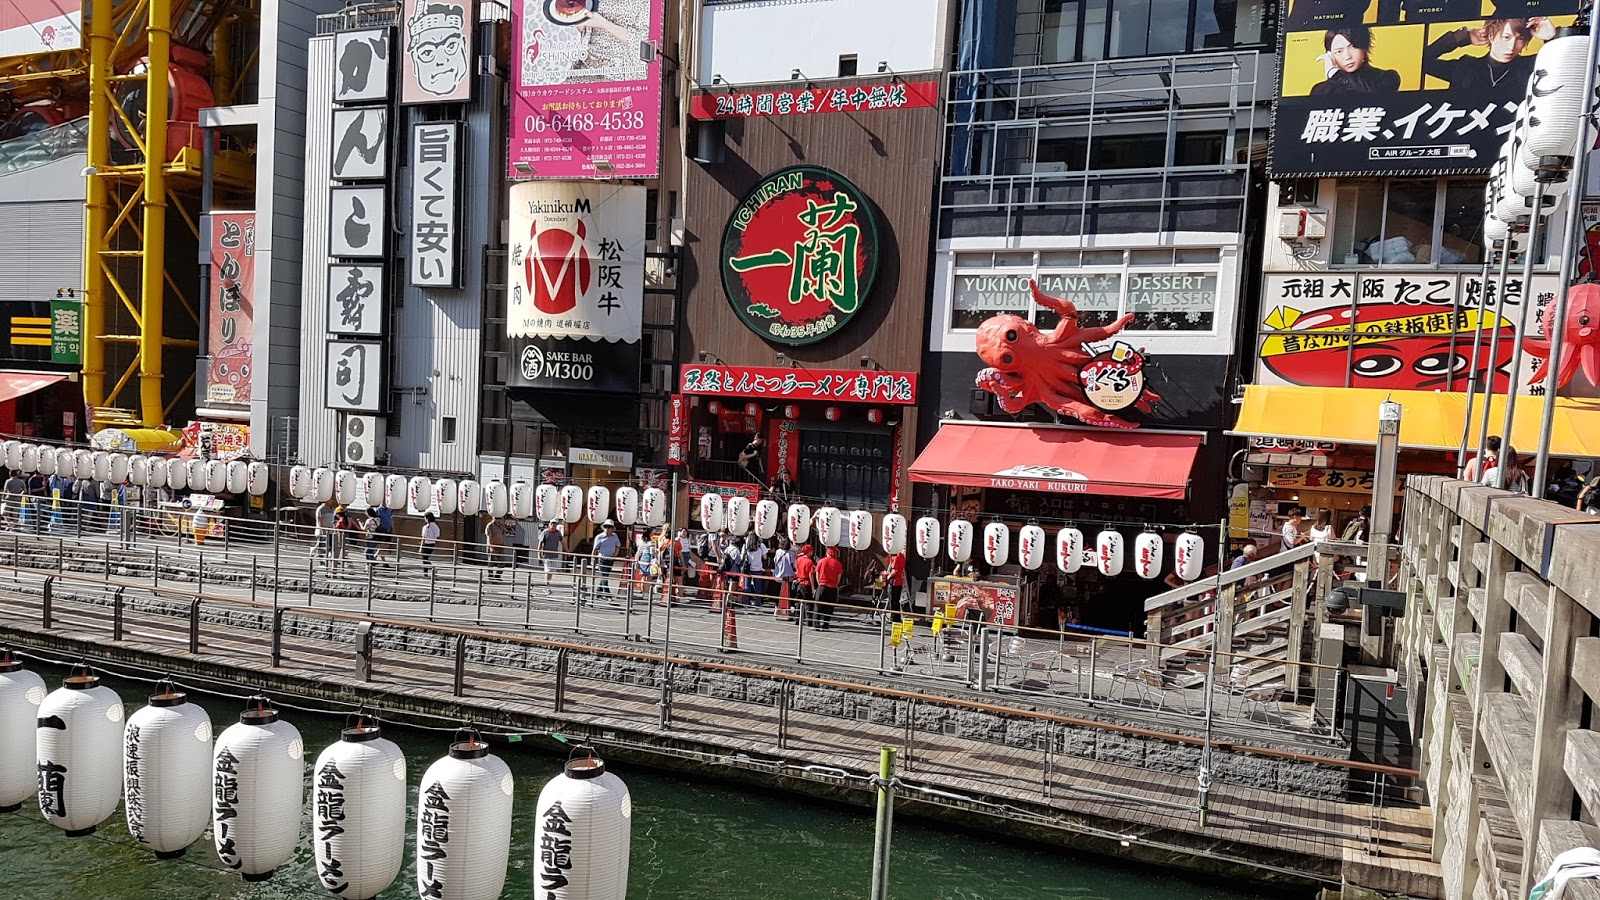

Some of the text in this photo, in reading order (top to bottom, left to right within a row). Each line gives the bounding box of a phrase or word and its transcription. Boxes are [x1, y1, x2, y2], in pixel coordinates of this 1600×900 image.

[541, 42, 588, 51] MADAME
[524, 110, 645, 133] 06-6468-4538
[416, 128, 450, 280] 旨くて安い
[733, 172, 803, 232] ICHIRAN
[730, 191, 860, 314] 一蘭
[219, 220, 242, 346] とんぼり
[511, 242, 524, 306] 焼肉
[596, 236, 626, 317] 松阪牛
[1130, 275, 1207, 291] DESSERT
[54, 308, 80, 336] 薬
[53, 335, 80, 343] Medicine
[54, 341, 67, 354] 药
[69, 343, 80, 356] 약
[524, 358, 539, 377] 酒
[546, 351, 593, 364] SAKE BAR
[545, 362, 594, 381] M300
[683, 368, 913, 400] 天然とんこつラーメン専門店
[990, 478, 1088, 492] TAKO-YAKI KUKURU
[214, 745, 243, 870] 金龍ラーメン
[316, 756, 349, 895] 金龍ラーメン
